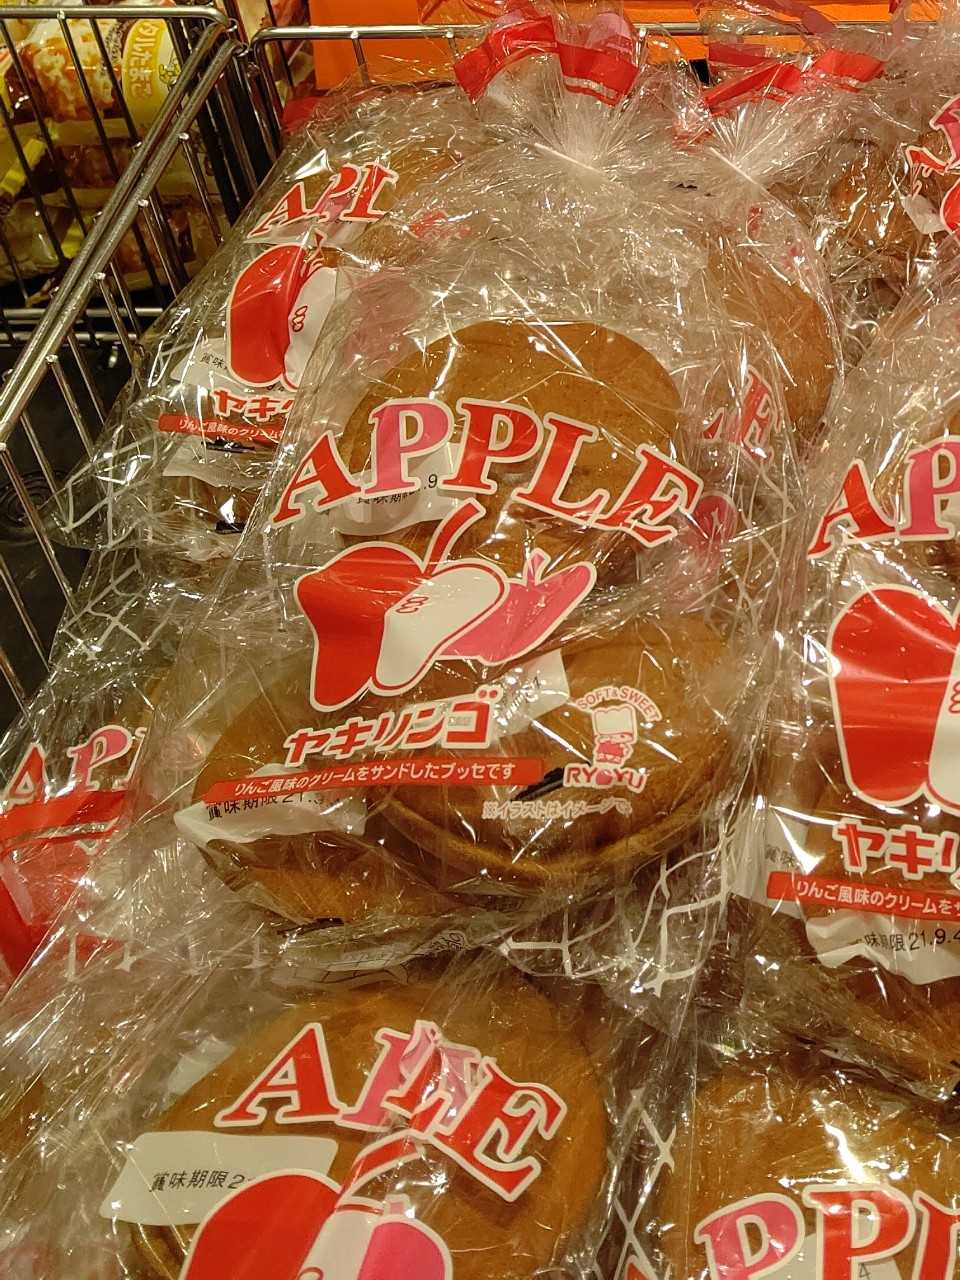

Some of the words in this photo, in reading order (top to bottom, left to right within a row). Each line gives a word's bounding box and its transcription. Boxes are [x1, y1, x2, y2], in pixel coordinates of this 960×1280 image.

[271, 396, 704, 547] APPLE
[283, 682, 504, 768] ヤキリンゴ
